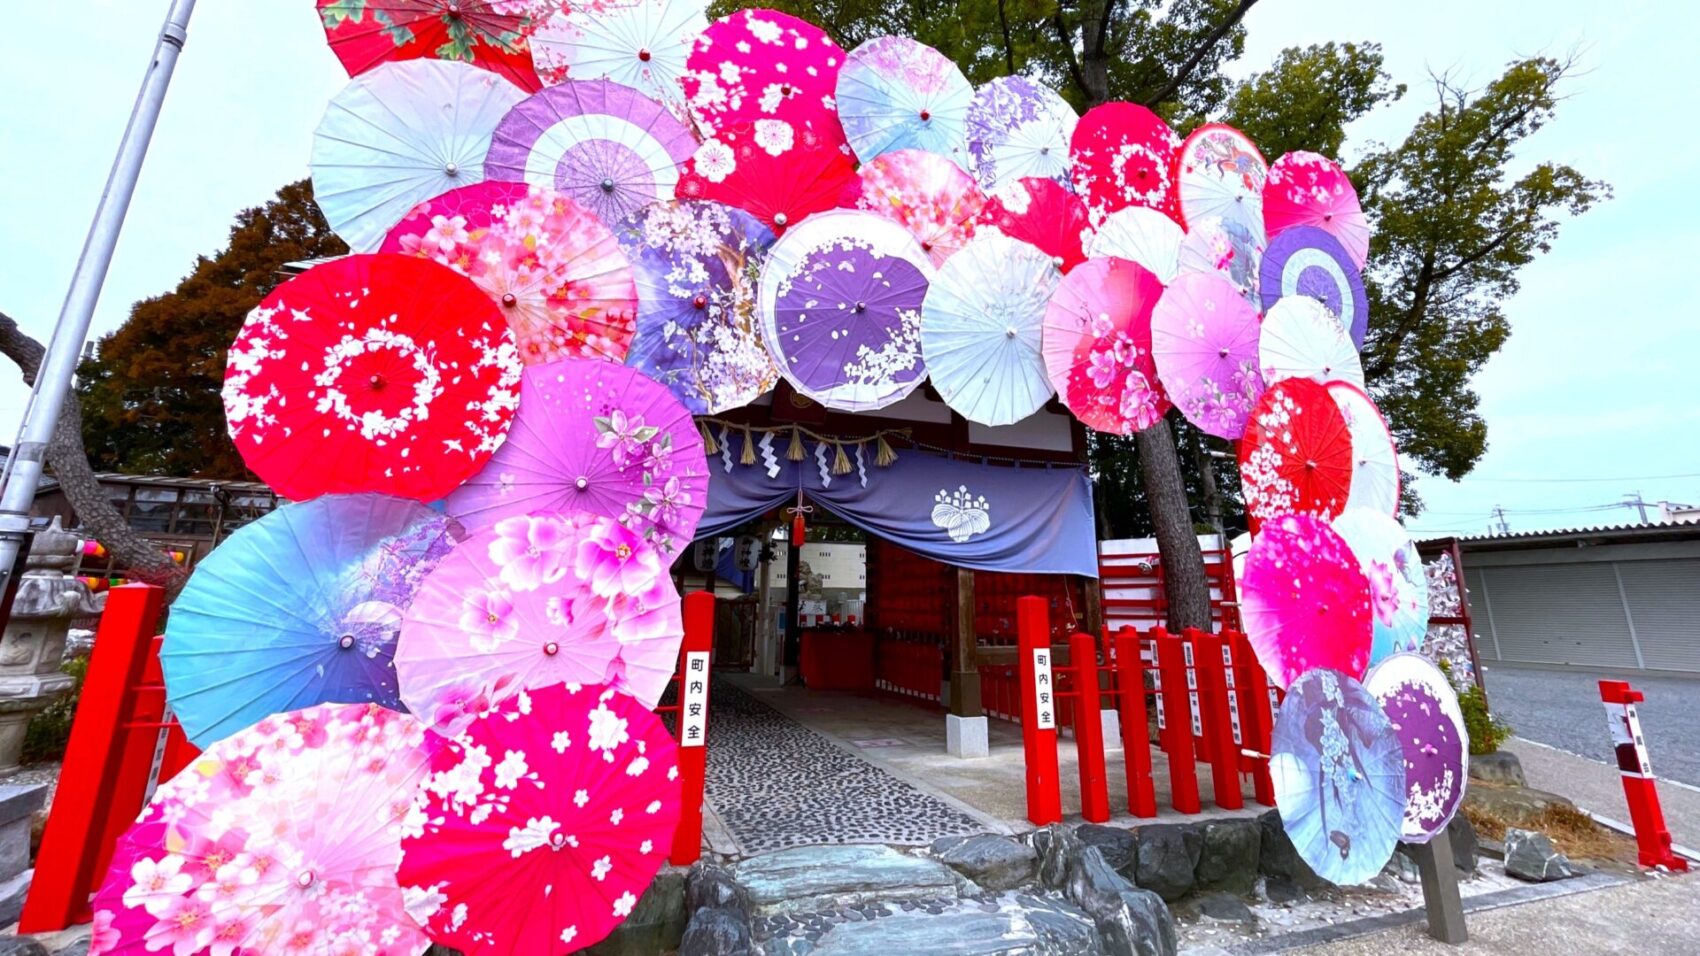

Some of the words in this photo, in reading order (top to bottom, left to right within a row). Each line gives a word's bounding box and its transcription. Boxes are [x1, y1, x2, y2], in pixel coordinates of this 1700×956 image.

[687, 658, 704, 739] 町内安全
[1037, 654, 1050, 723] 町内安全
